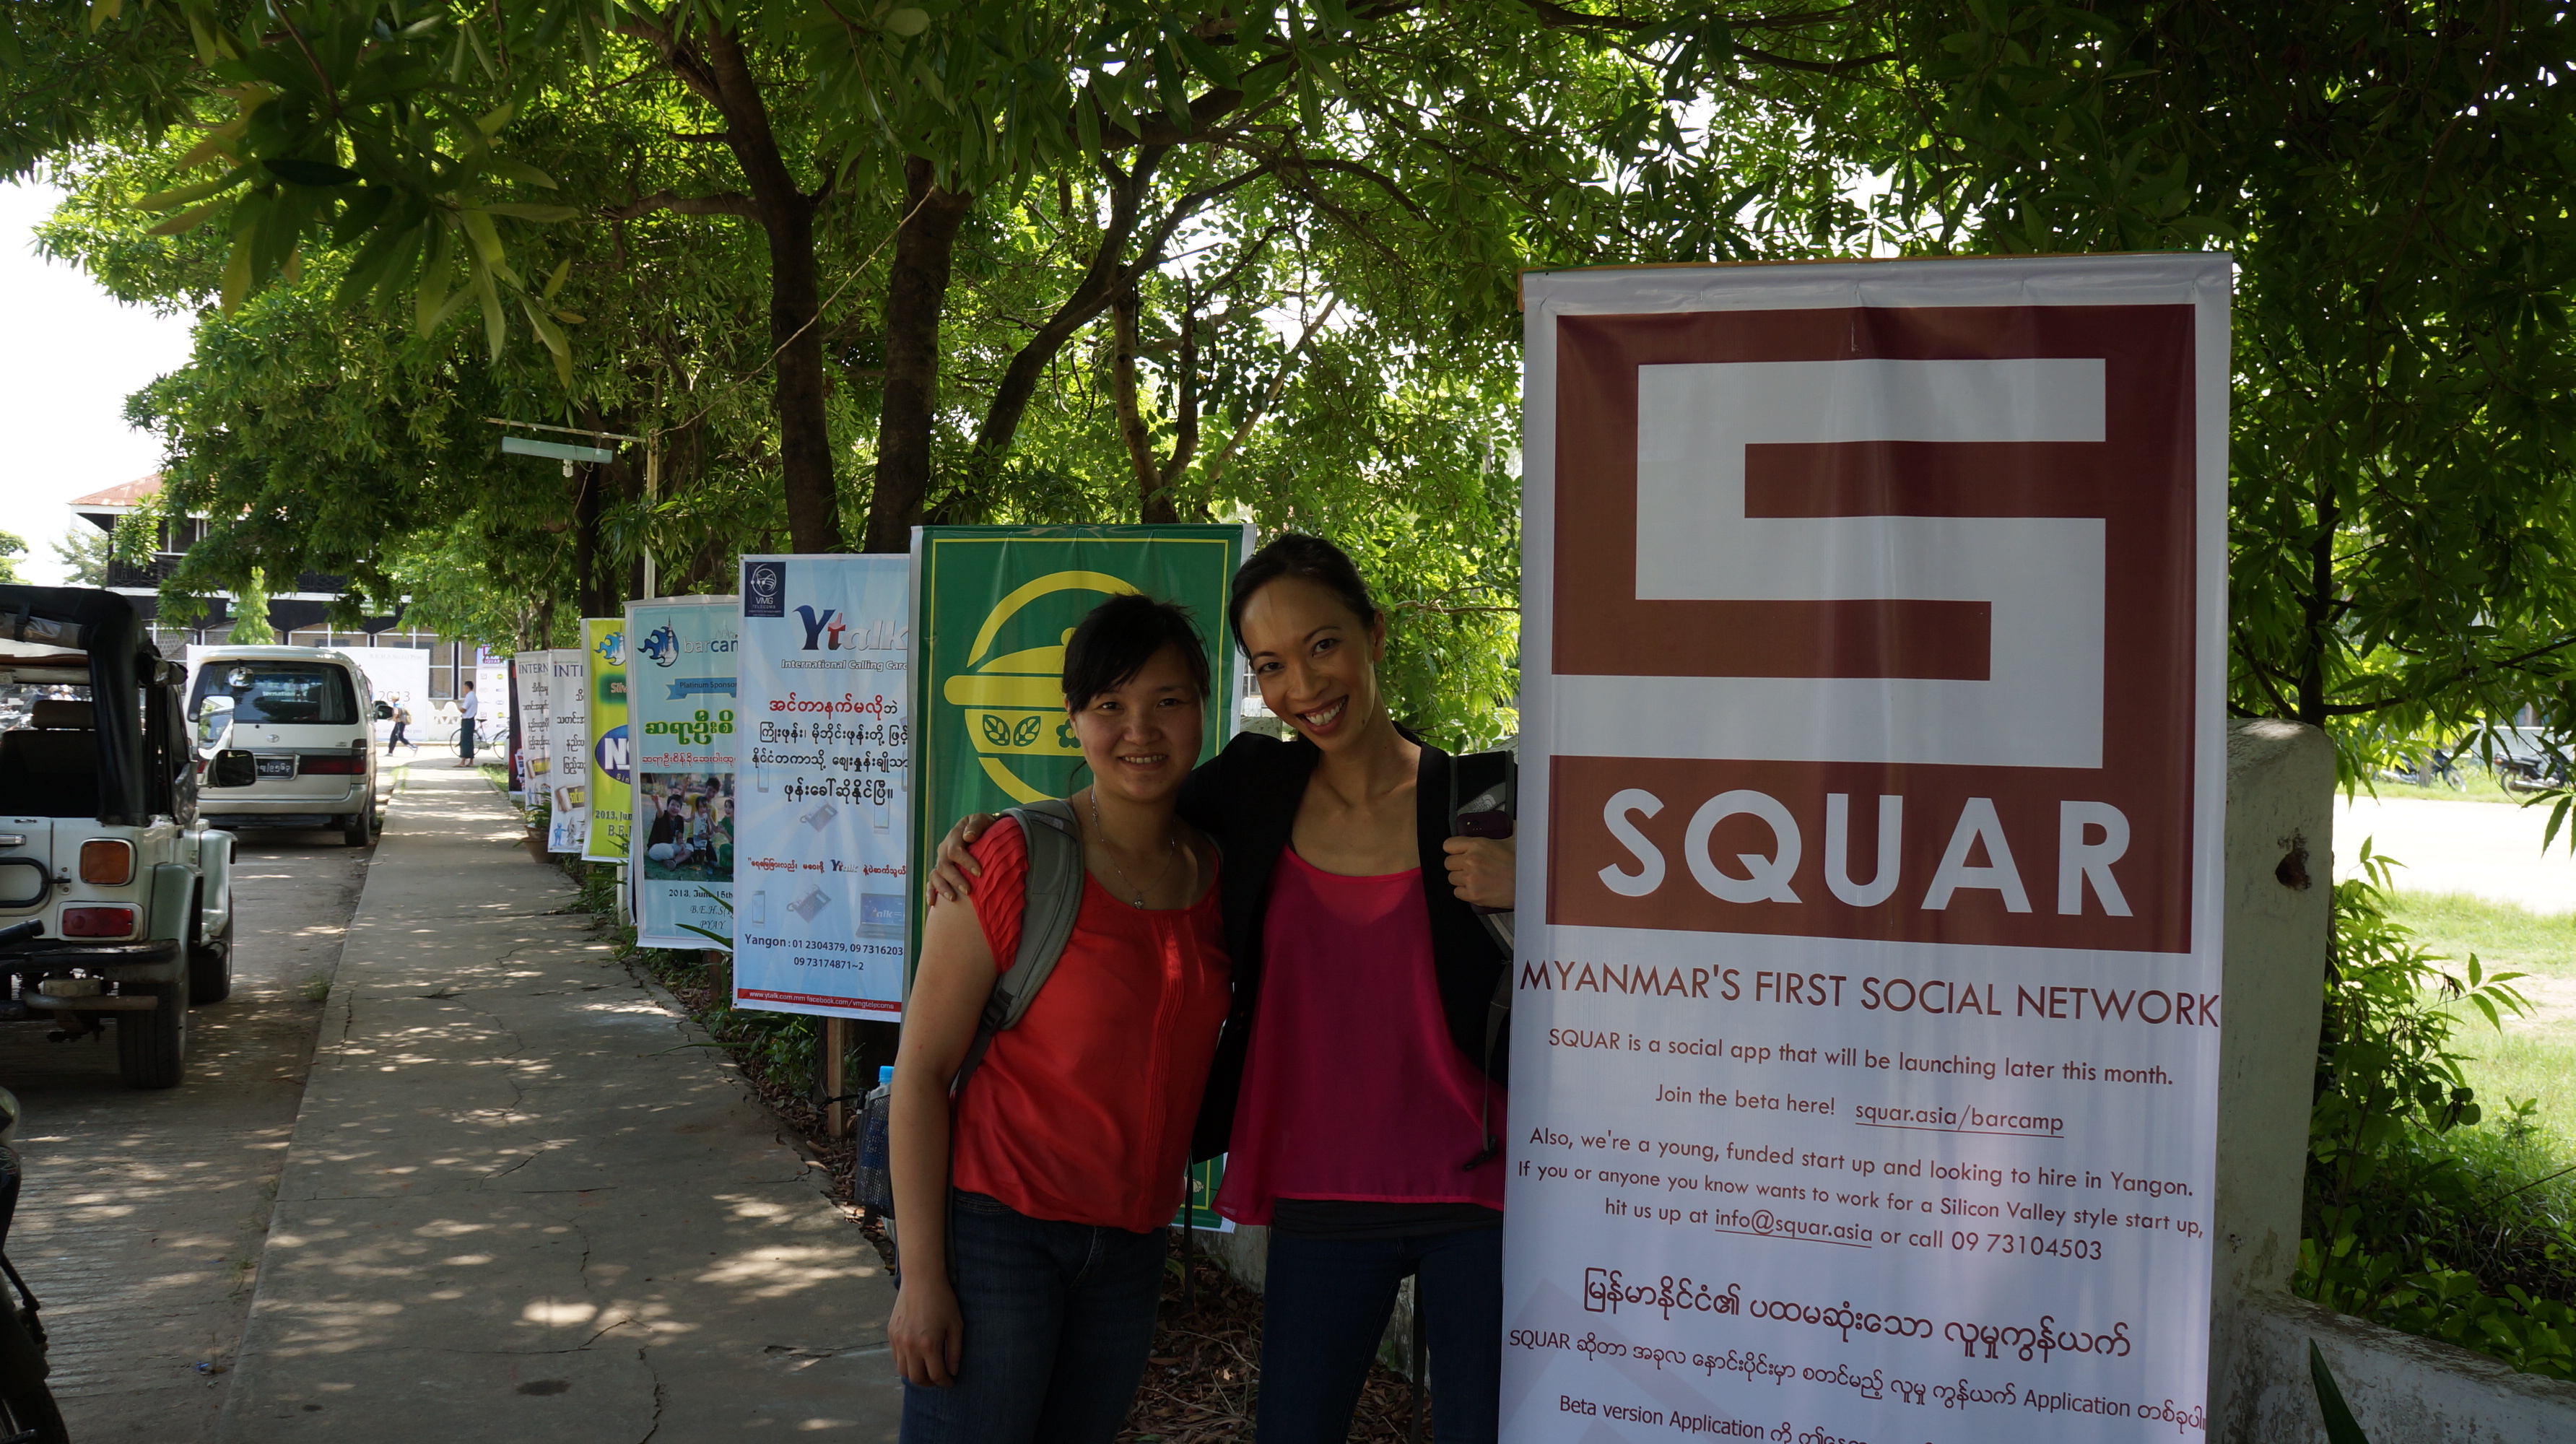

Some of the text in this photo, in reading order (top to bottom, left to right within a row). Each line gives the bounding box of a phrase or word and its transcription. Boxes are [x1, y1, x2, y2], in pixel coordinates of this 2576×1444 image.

[755, 596, 774, 605] VMG
[792, 604, 909, 651] Ytalk
[781, 659, 846, 669] International
[848, 660, 884, 672] Calling
[595, 810, 618, 820] 2013,
[1597, 787, 2134, 918] SQUAR
[669, 889, 691, 898] 2013,
[700, 920, 726, 930] PYAY
[805, 940, 848, 953] 2304379,
[850, 943, 861, 953] 09
[863, 944, 903, 956] 7316203
[794, 957, 805, 966] 09
[749, 991, 895, 1009] www.ytalk.com.mm facebook.com/vmgtelecoms
[1519, 959, 2219, 1027] MYANMAR'S FIRST SOCIAL NETWORK
[1548, 1028, 2173, 1085] SQUAR is a social app that will be launching later this month.
[1655, 1084, 2064, 1136] Join the beta here! squar.asia/barcamp
[1529, 1126, 2193, 1199] Also, we're a young, funded start up and looking to hire in Yangon.
[1518, 1160, 2203, 1239] If you or anyone you know wants to work for a Silicon Valley style start up,
[1605, 1197, 2102, 1261] hit us up at info@squar.asia or call 09 73104503
[1584, 1266, 1741, 1321] မြန်မာနိုင်ငံ၏
[1749, 1300, 1934, 1343] ပထမဆုံးသော
[1508, 1329, 1571, 1350] SQUAR
[1576, 1331, 1627, 1361] ဆိုတာ
[1632, 1344, 1687, 1370] အခုလ
[2023, 1388, 2131, 1417] Application
[1559, 1394, 1597, 1416] Beta
[1602, 1404, 1663, 1425] version
[1668, 1411, 1765, 1440] Application
